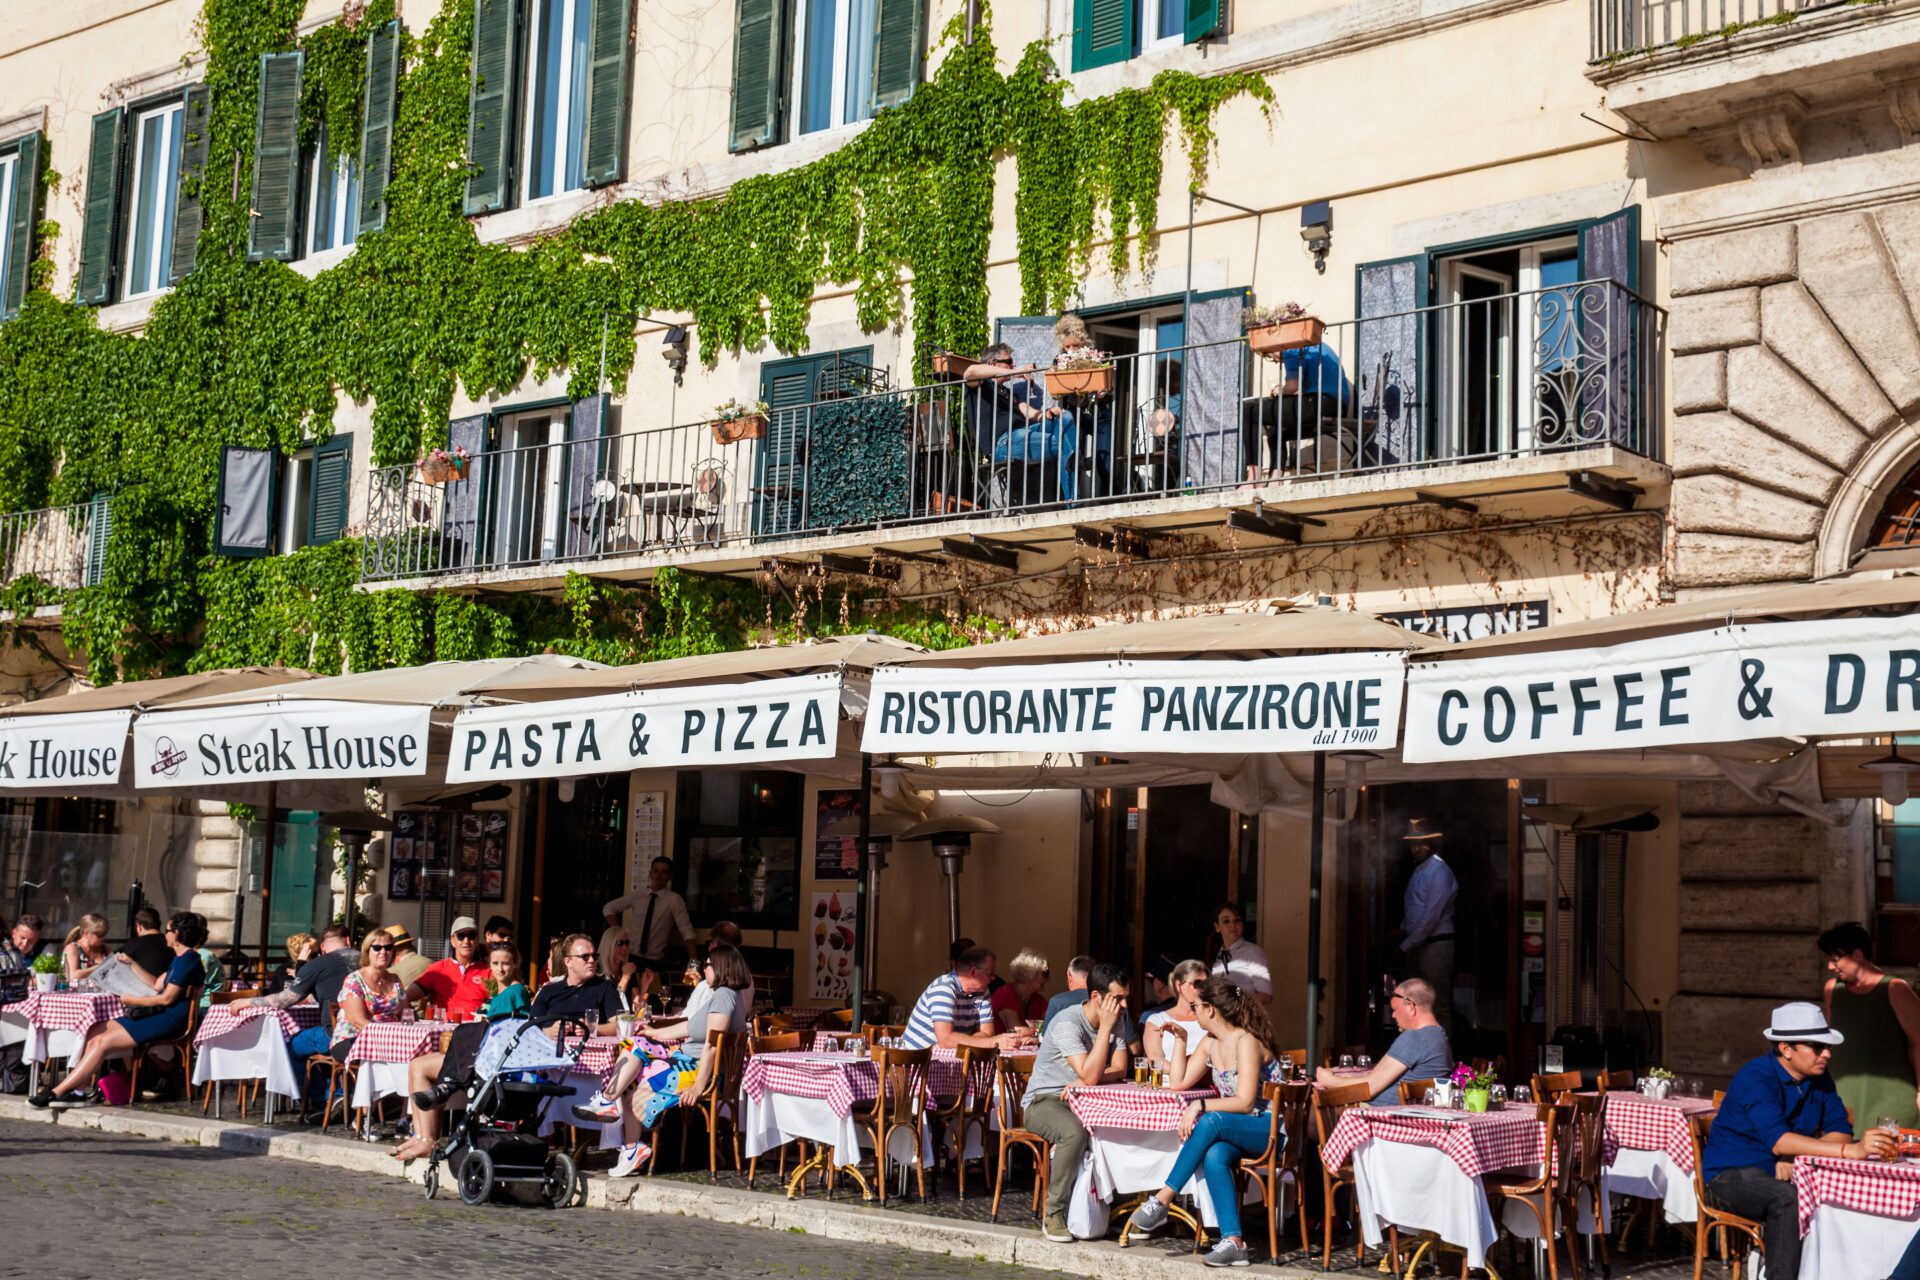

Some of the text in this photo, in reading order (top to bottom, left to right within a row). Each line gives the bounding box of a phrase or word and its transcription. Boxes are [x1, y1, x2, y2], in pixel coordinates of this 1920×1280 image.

[880, 678, 1382, 734] RISTORANTE PANZIRONE
[1438, 666, 1691, 746] COFFEE
[1737, 658, 1774, 720] &
[26, 739, 117, 779] House
[198, 725, 417, 776] Steak House
[464, 699, 826, 771] PASTA & PIZZA
[1312, 728, 1378, 745] dal 1900
